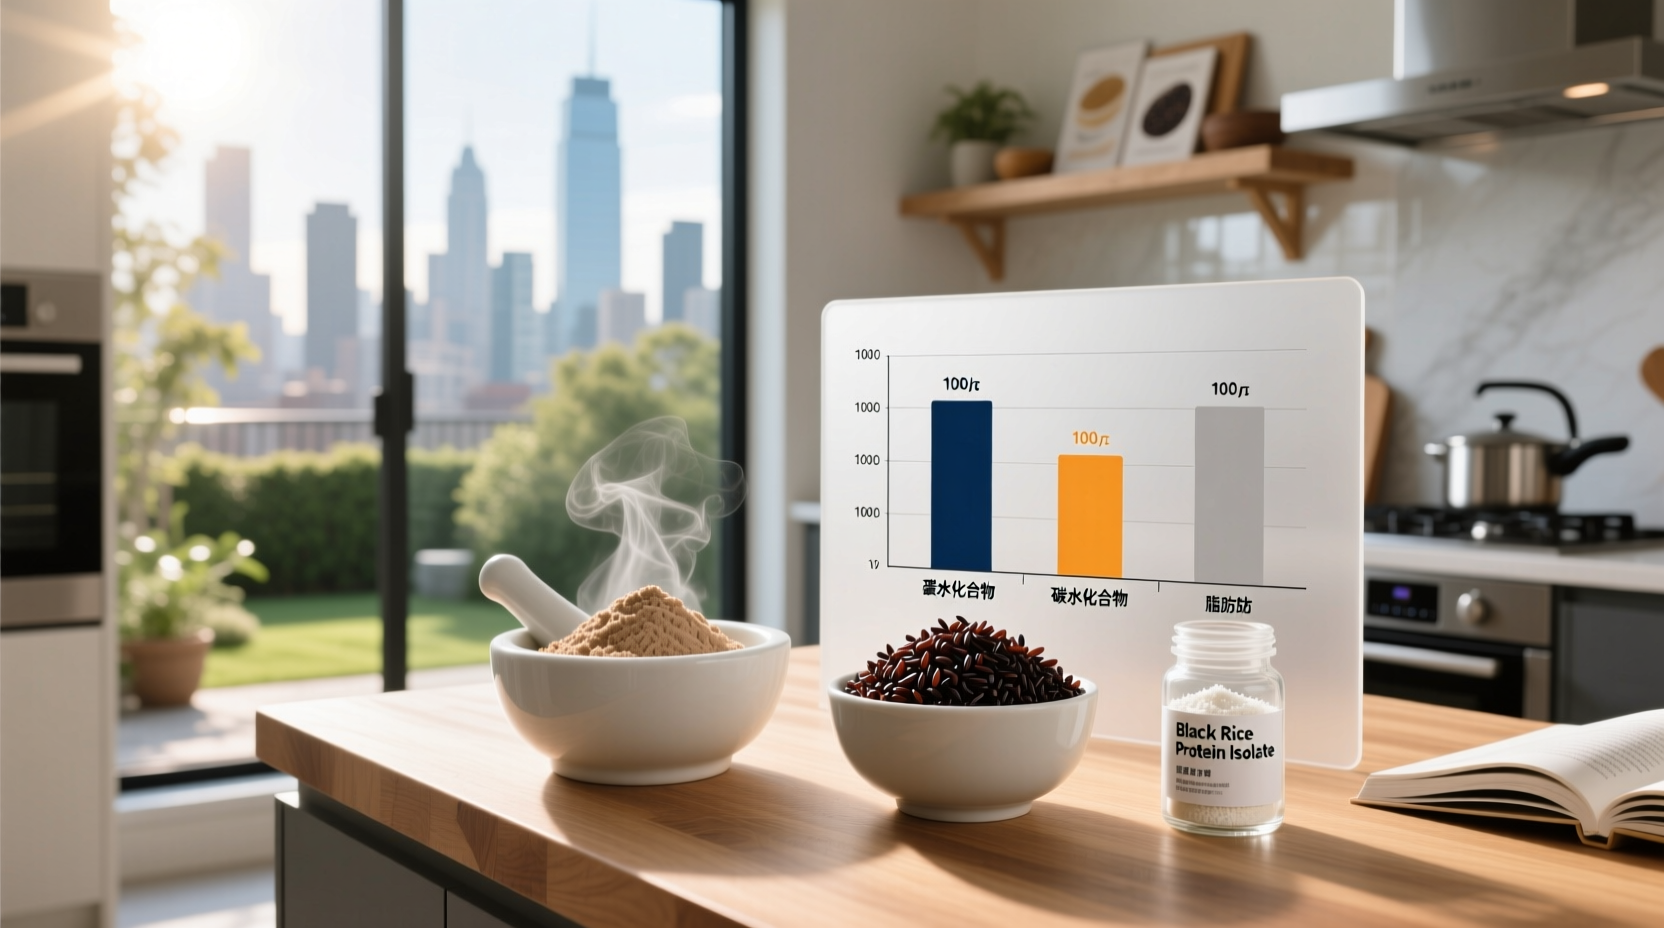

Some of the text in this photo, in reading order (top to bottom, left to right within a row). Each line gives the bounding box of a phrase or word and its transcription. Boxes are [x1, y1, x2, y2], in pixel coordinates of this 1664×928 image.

[855, 401, 881, 413] 1000
[855, 453, 881, 466] 1000
[855, 506, 881, 519] 1000
[1050, 586, 1129, 608] 碳水化合物
[1176, 721, 1254, 741] Black Rice
[1175, 741, 1275, 760] Protein Isolate
